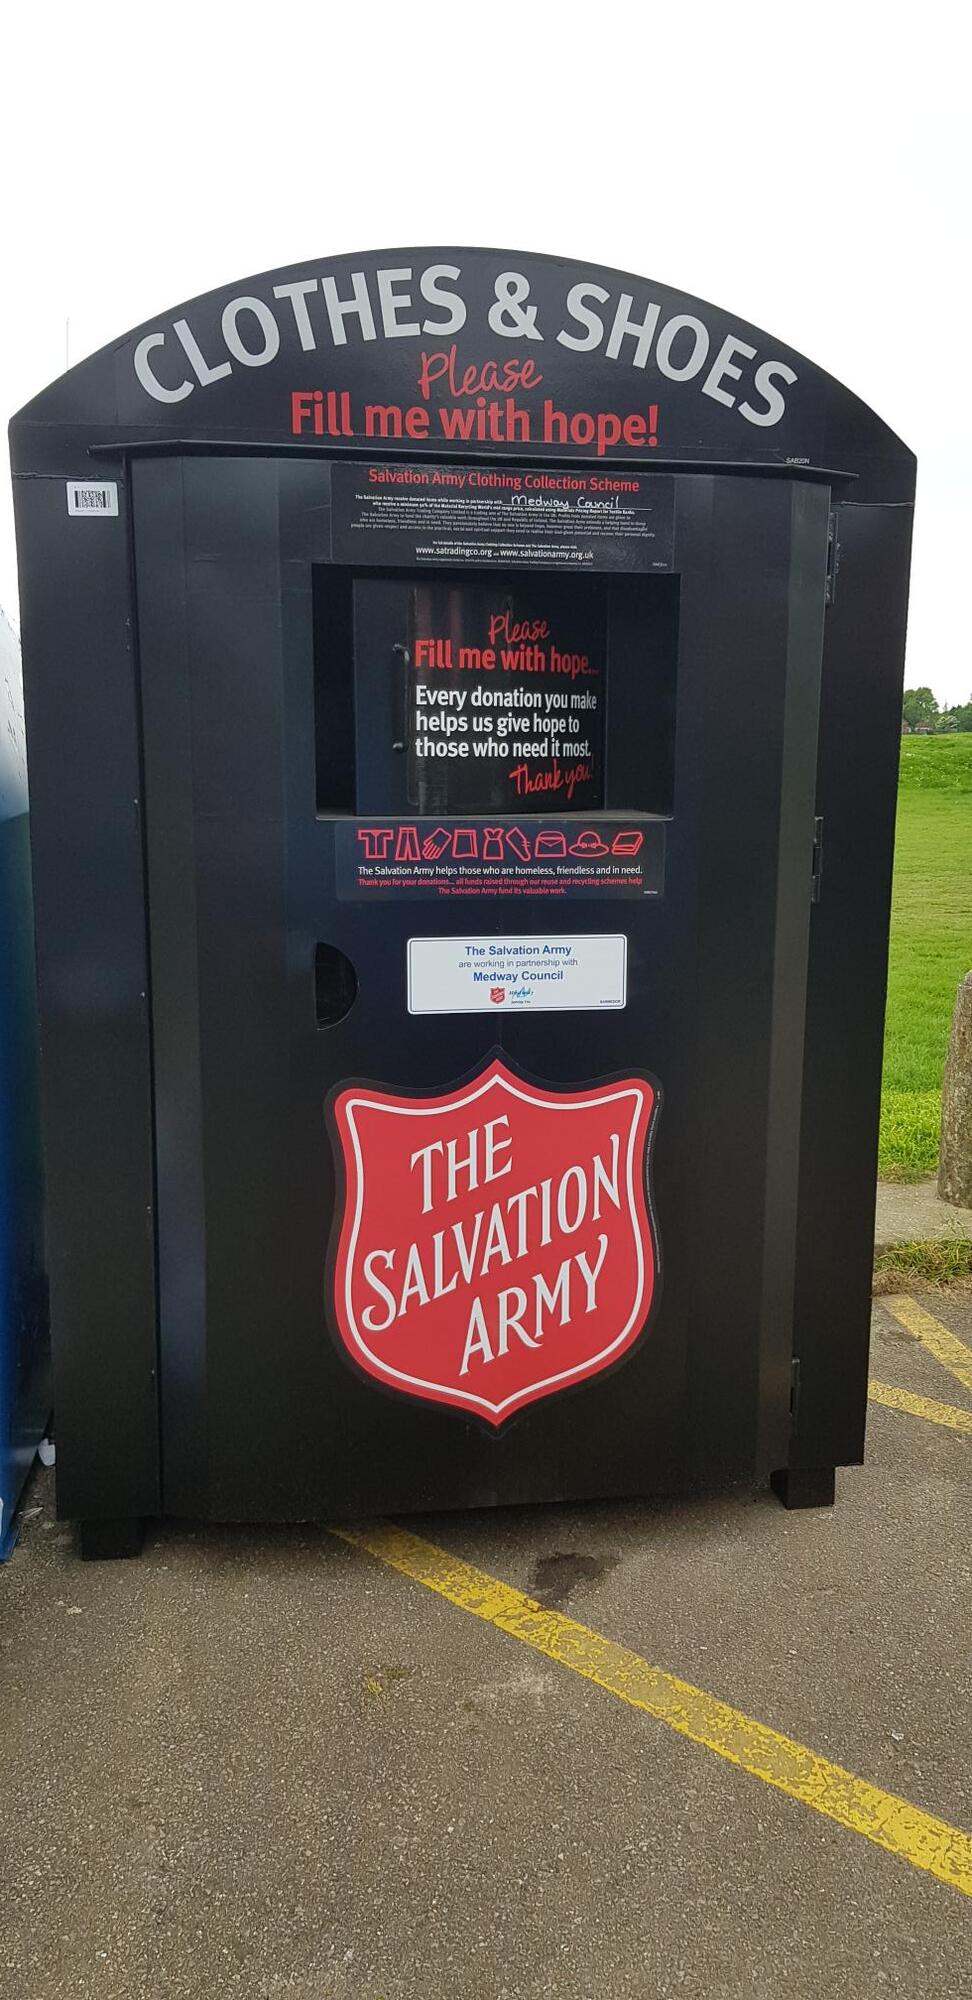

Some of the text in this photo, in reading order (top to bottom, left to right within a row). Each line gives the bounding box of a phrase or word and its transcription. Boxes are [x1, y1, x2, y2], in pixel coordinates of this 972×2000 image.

[134, 264, 799, 427] CLOTHES & SHOES
[418, 344, 544, 399] Please
[291, 391, 659, 456] Fill me with hope!
[368, 468, 640, 492] Salvation Army Clothing Collection Scheme
[512, 495, 619, 509] Medway Council
[416, 546, 492, 558] www.satradingco.org
[500, 549, 594, 560] www.salvationarmy.org.uk
[488, 610, 550, 646] Please
[414, 639, 453, 669] Fill
[458, 647, 496, 670] me
[501, 644, 546, 672] with
[416, 684, 597, 713] Every donation you make
[416, 710, 579, 737] helps us give hope to
[415, 737, 592, 758] those who need it most.
[508, 758, 563, 795] Thank
[358, 866, 643, 876] The Salvation Army helps those who are homeless, friendless and in need.
[504, 878, 528, 886] through
[572, 878, 600, 886] recycling
[628, 878, 643, 886] help
[481, 888, 497, 896] Army
[464, 945, 572, 956] The Salvation Army
[474, 960, 505, 969] working
[507, 960, 514, 968] in
[516, 959, 560, 968] partnership
[561, 958, 578, 966] with
[473, 970, 564, 983] Medway Council
[410, 1114, 513, 1214] THE
[361, 1134, 621, 1331] SALVATION
[459, 1234, 608, 1377] ARMY
